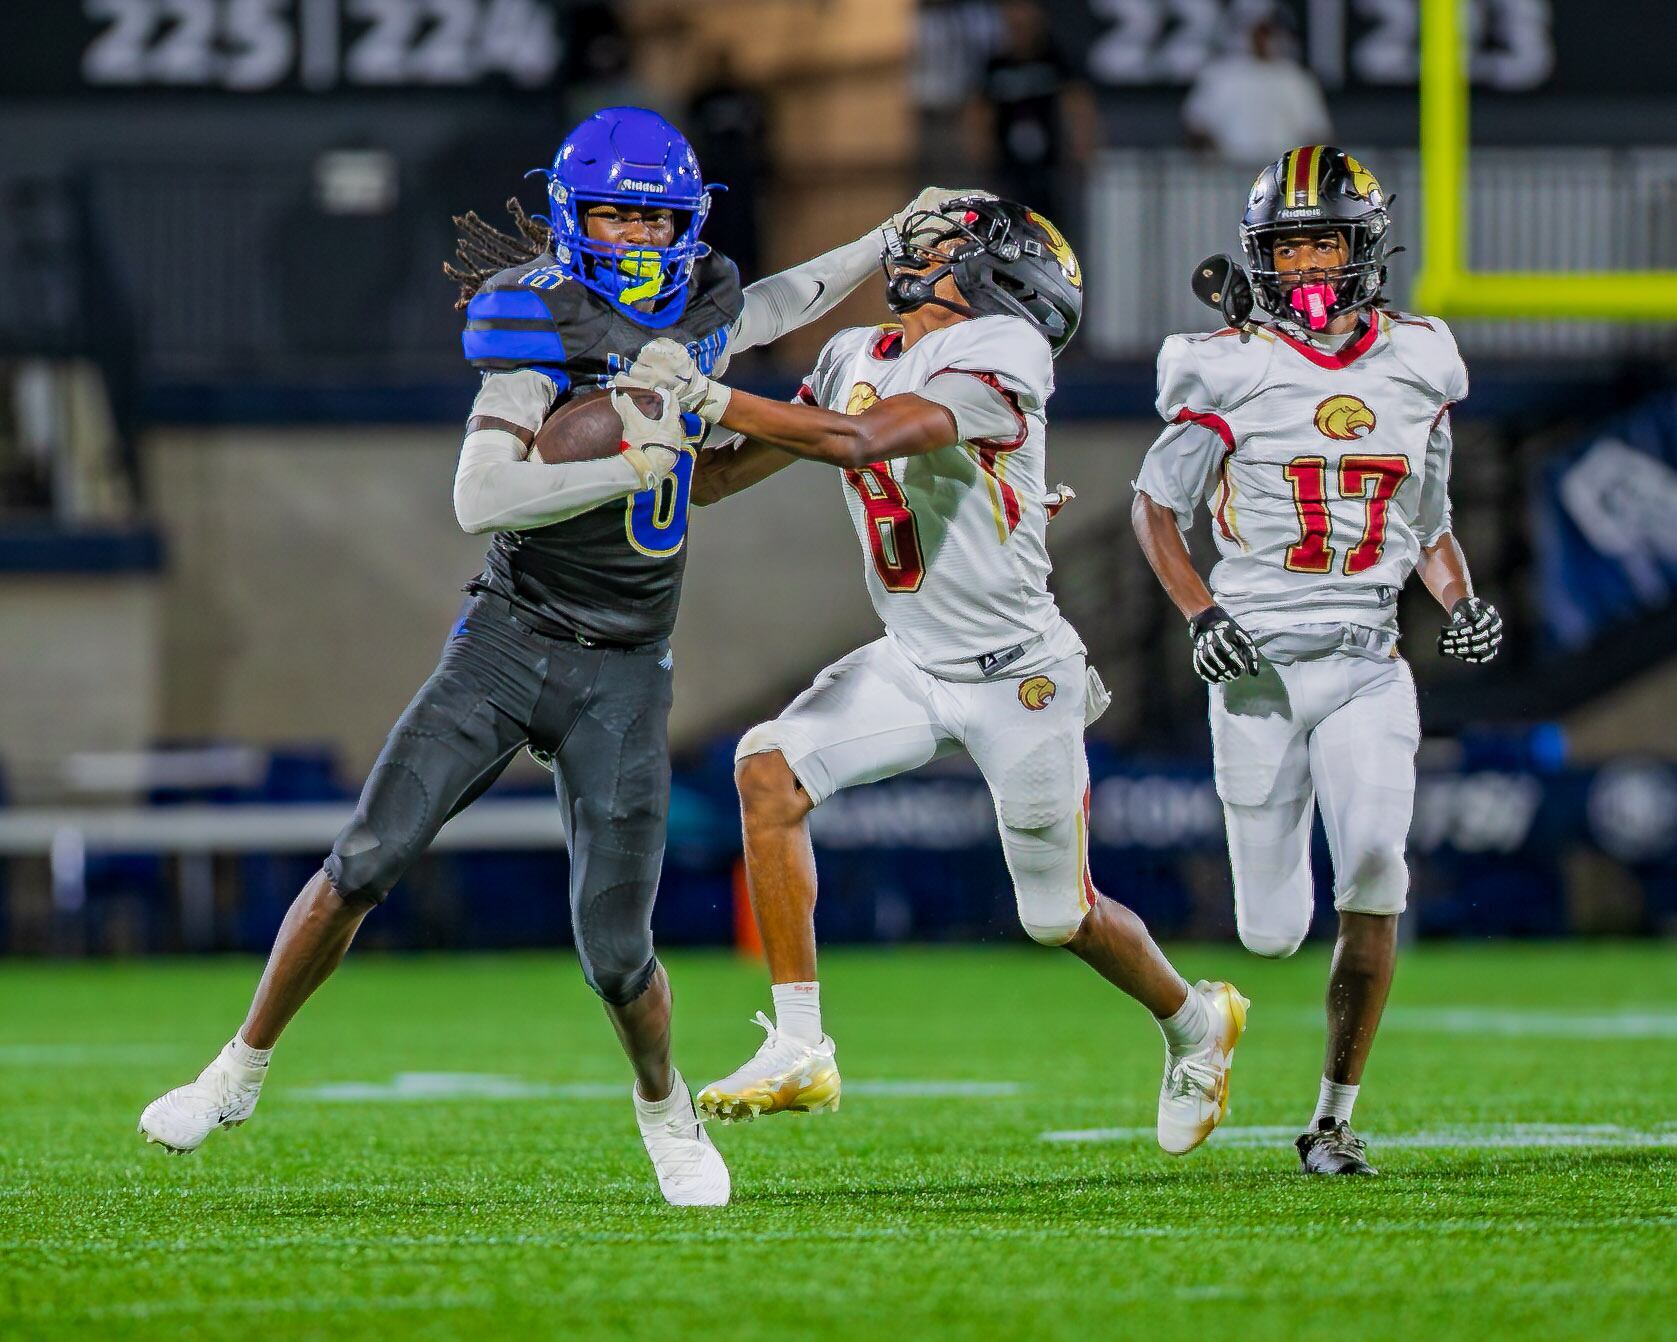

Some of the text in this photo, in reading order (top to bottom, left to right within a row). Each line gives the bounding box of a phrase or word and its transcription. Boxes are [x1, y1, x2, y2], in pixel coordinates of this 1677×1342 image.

[82, 0, 296, 88] 225
[1350, 0, 1556, 90] 23
[843, 460, 927, 594] 8
[1283, 453, 1412, 576] 17
